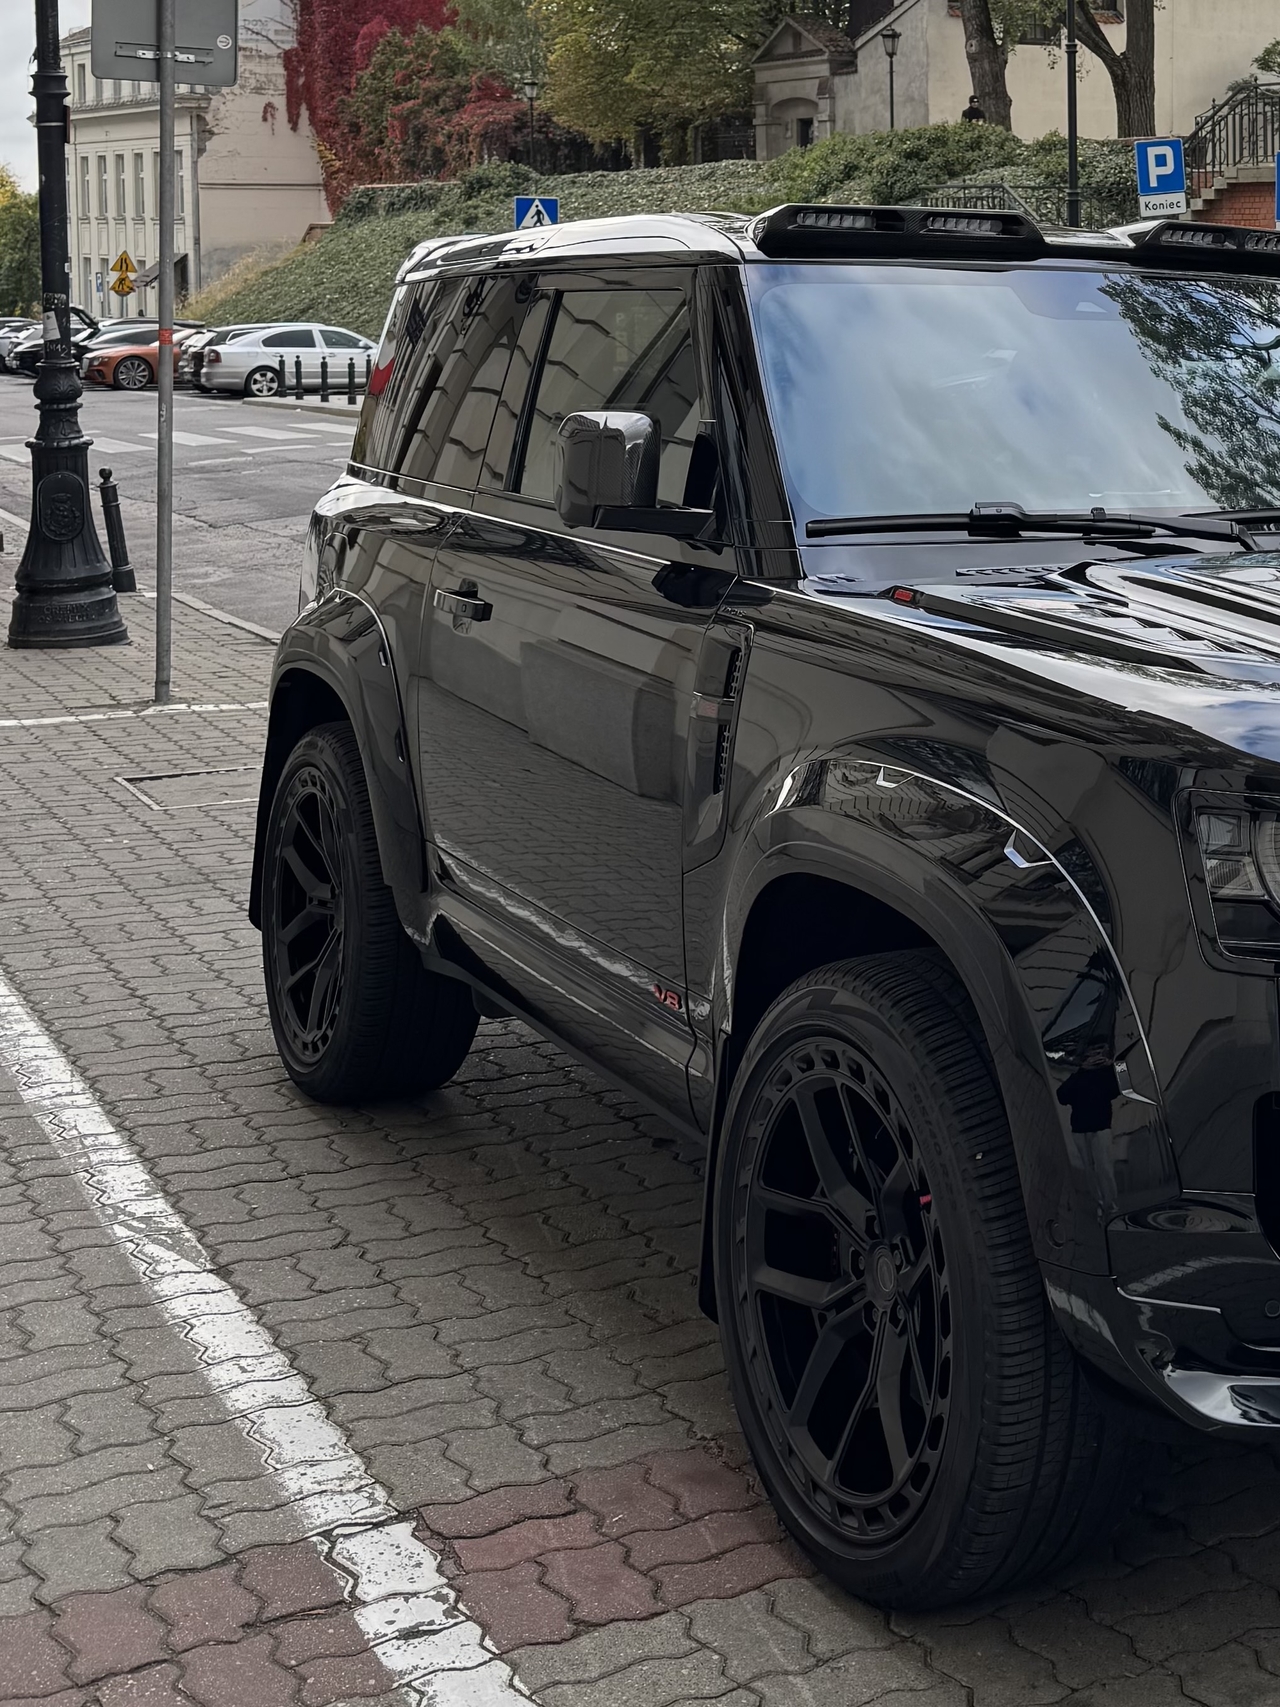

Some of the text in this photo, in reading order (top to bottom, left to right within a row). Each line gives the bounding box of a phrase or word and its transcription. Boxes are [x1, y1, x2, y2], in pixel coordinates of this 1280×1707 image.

[1147, 146, 1174, 188] P
[1144, 199, 1182, 212] Koniec
[652, 983, 679, 1011] V8
